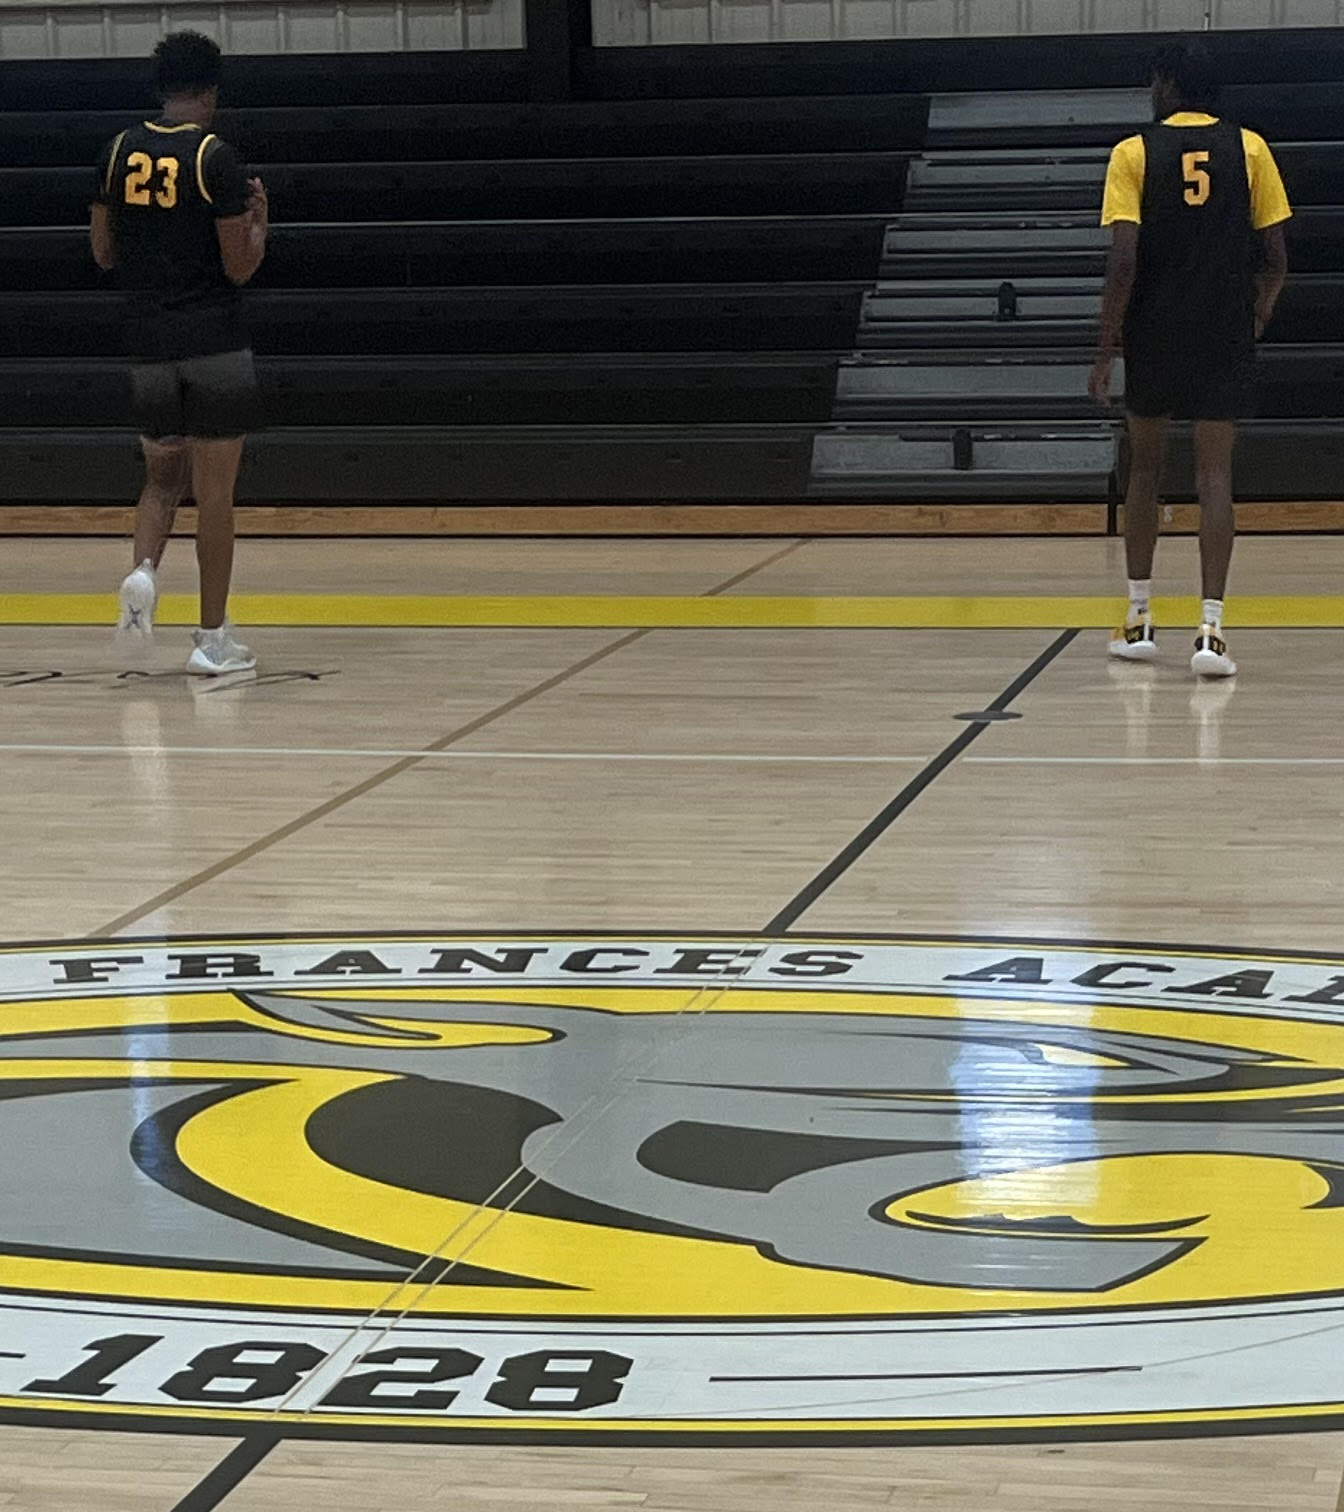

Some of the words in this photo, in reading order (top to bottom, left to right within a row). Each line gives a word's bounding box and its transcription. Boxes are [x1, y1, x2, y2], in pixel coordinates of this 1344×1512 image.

[125, 151, 179, 208] 23
[1181, 150, 1211, 206] 5
[48, 947, 864, 985] FRANCES
[18, 1333, 635, 1412] 1828
